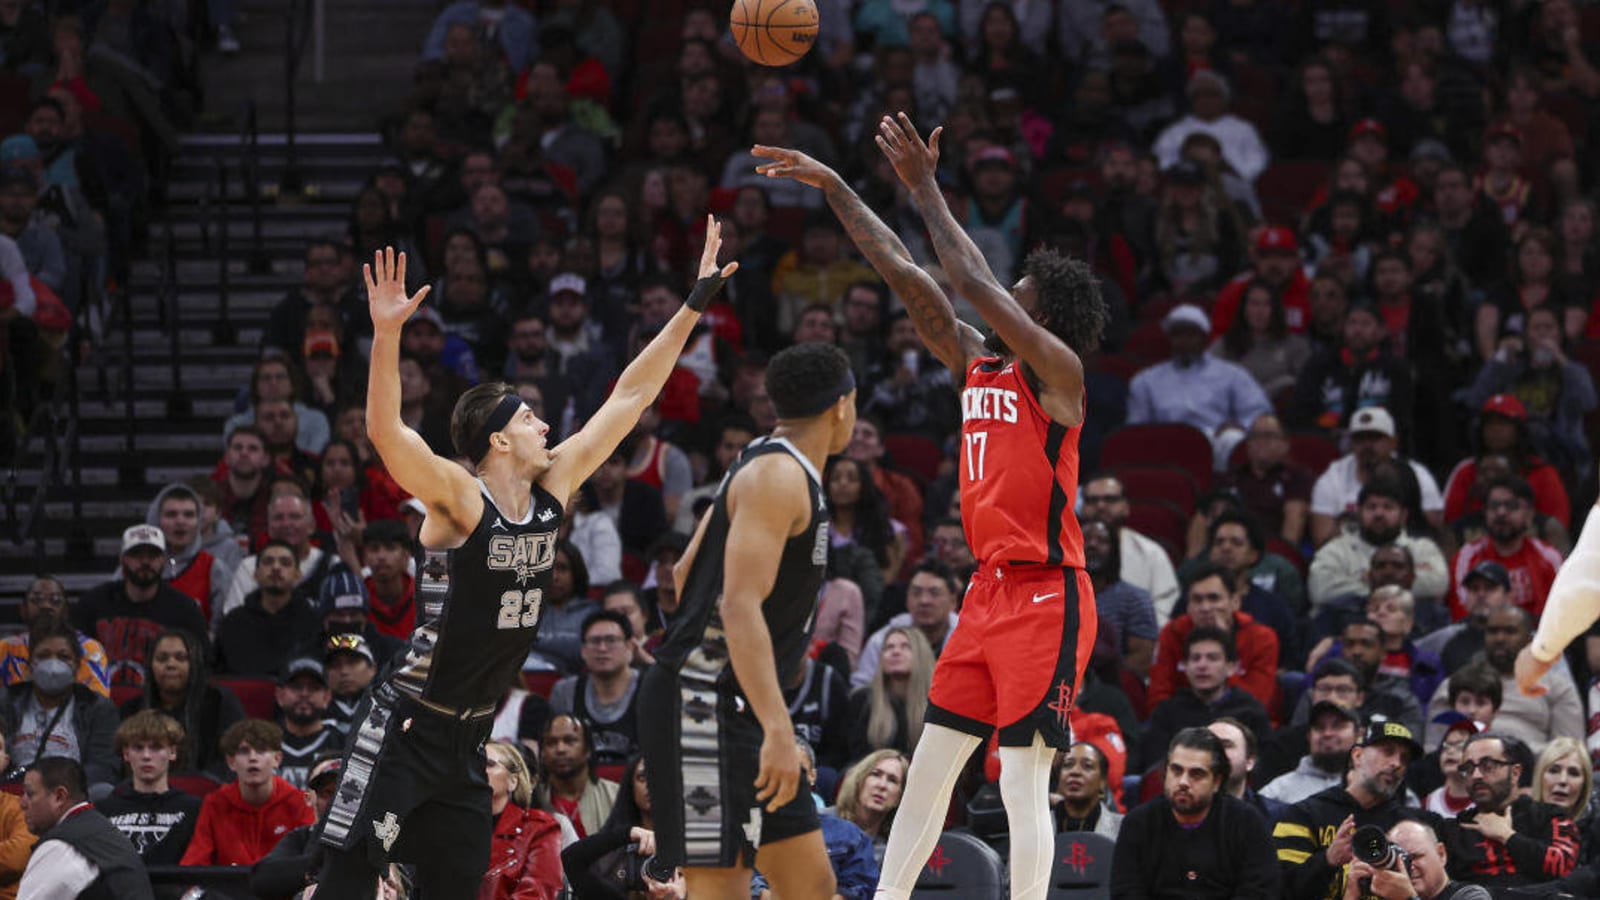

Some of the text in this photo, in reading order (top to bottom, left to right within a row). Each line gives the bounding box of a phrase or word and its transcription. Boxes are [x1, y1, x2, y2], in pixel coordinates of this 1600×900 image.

[965, 431, 987, 481] 17
[487, 528, 559, 570] SATX
[497, 588, 543, 629] 23
